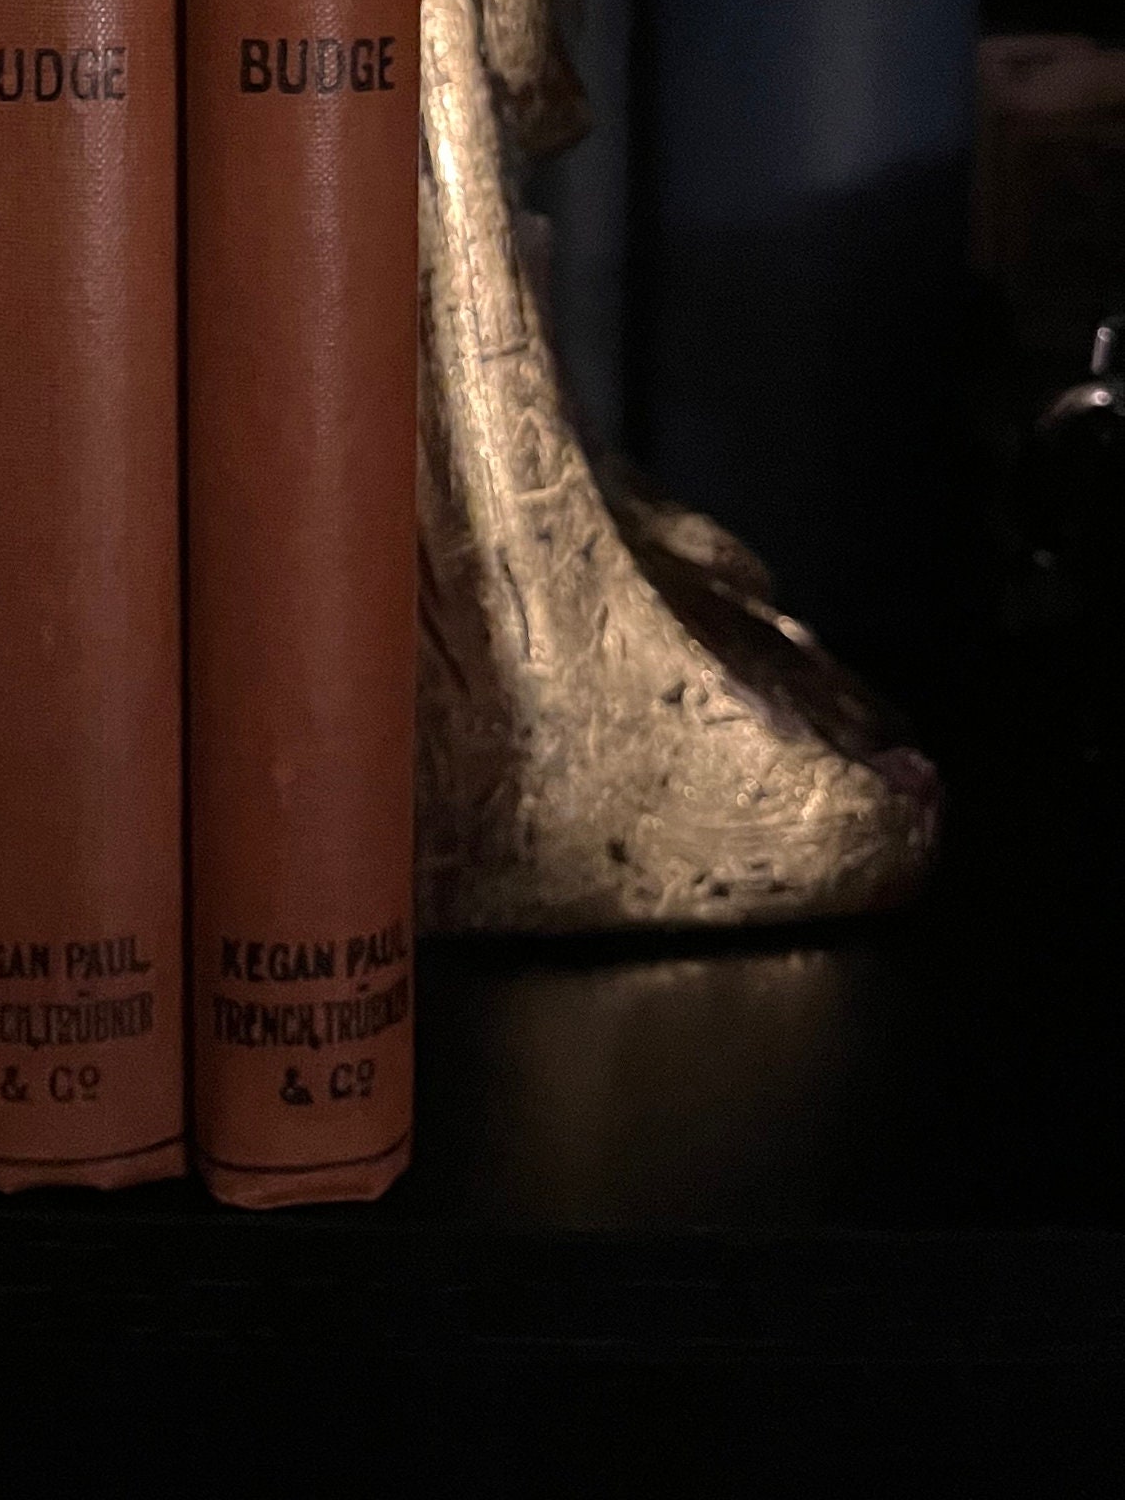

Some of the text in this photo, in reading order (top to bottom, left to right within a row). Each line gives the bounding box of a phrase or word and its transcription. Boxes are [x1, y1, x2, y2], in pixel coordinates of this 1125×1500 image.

[239, 36, 397, 95] BUDGE
[221, 933, 335, 982] KEGAN
[279, 1065, 315, 1106] &
